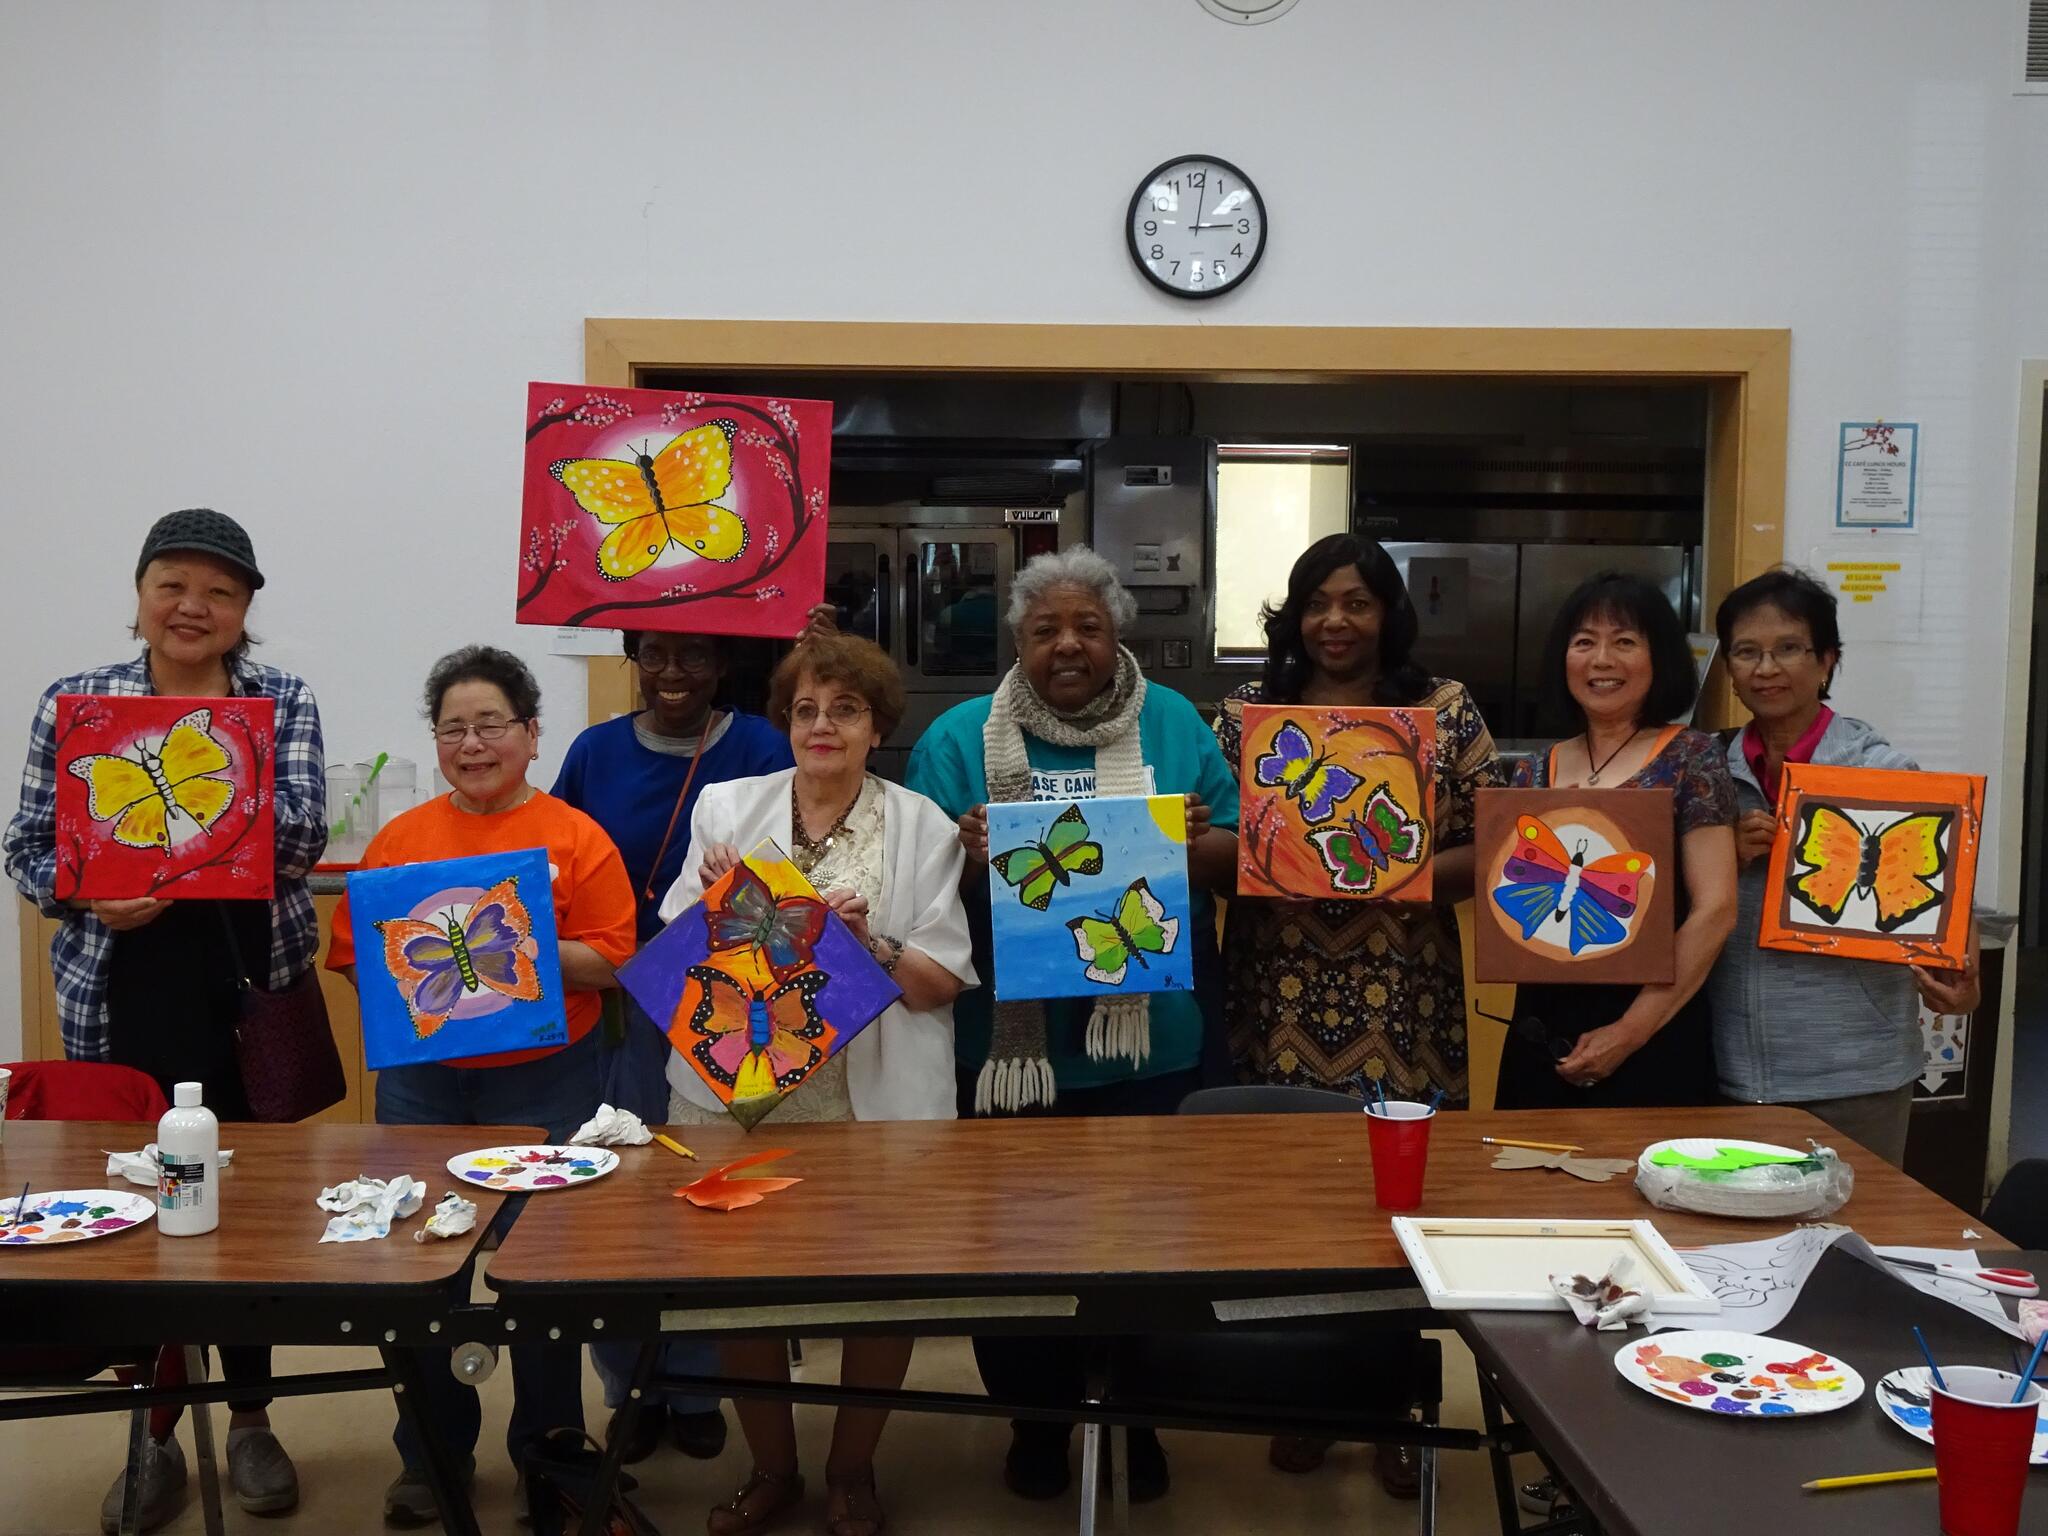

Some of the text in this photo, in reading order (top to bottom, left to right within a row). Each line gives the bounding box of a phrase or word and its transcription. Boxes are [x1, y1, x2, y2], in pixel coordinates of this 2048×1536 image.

[1167, 180, 1180, 195] 11
[1186, 172, 1205, 188] 12
[1217, 179, 1223, 194] 1
[1152, 197, 1169, 212] 10
[1144, 220, 1157, 236] 9
[1237, 218, 1250, 234] 3
[1151, 244, 1164, 260] 8
[1231, 243, 1243, 258] 4
[1170, 261, 1180, 276] 7
[1193, 266, 1204, 282] 6
[1213, 260, 1226, 275] 5
[1012, 511, 1054, 521] VULCAN
